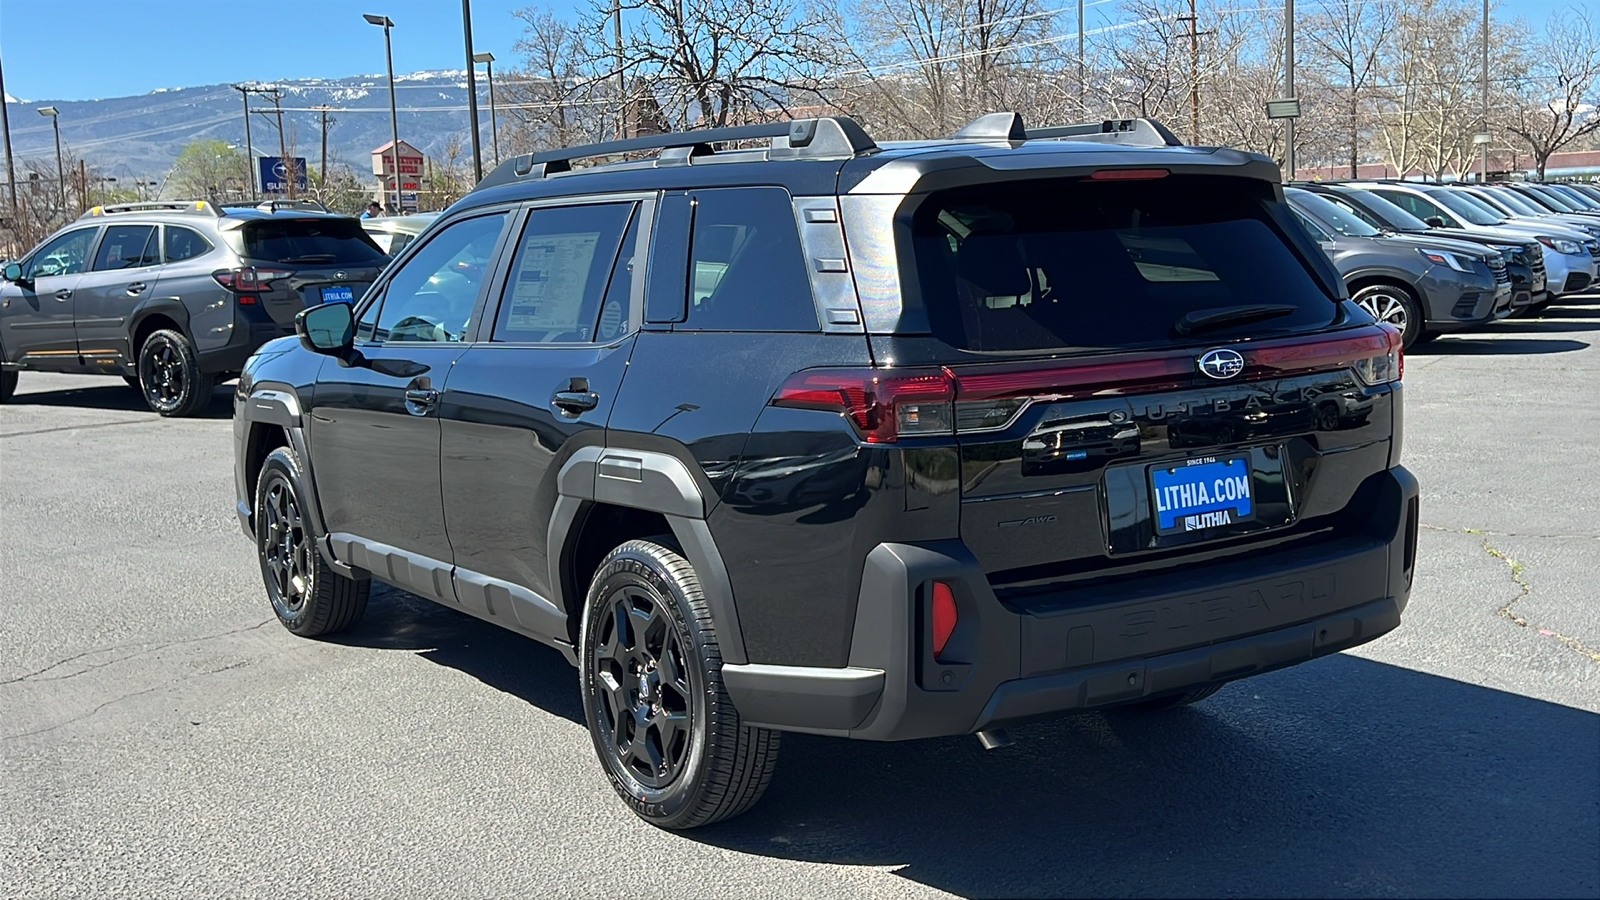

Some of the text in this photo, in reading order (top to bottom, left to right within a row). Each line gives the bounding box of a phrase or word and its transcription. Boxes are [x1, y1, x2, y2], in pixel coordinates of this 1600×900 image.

[1108, 387, 1323, 425] OUTBACK
[1186, 458, 1203, 467] SINCE
[1155, 474, 1251, 512] LITHIA.COM
[1016, 514, 1058, 526] AWD
[1195, 510, 1231, 530] LITHIA
[1119, 572, 1337, 638] SUBARU
